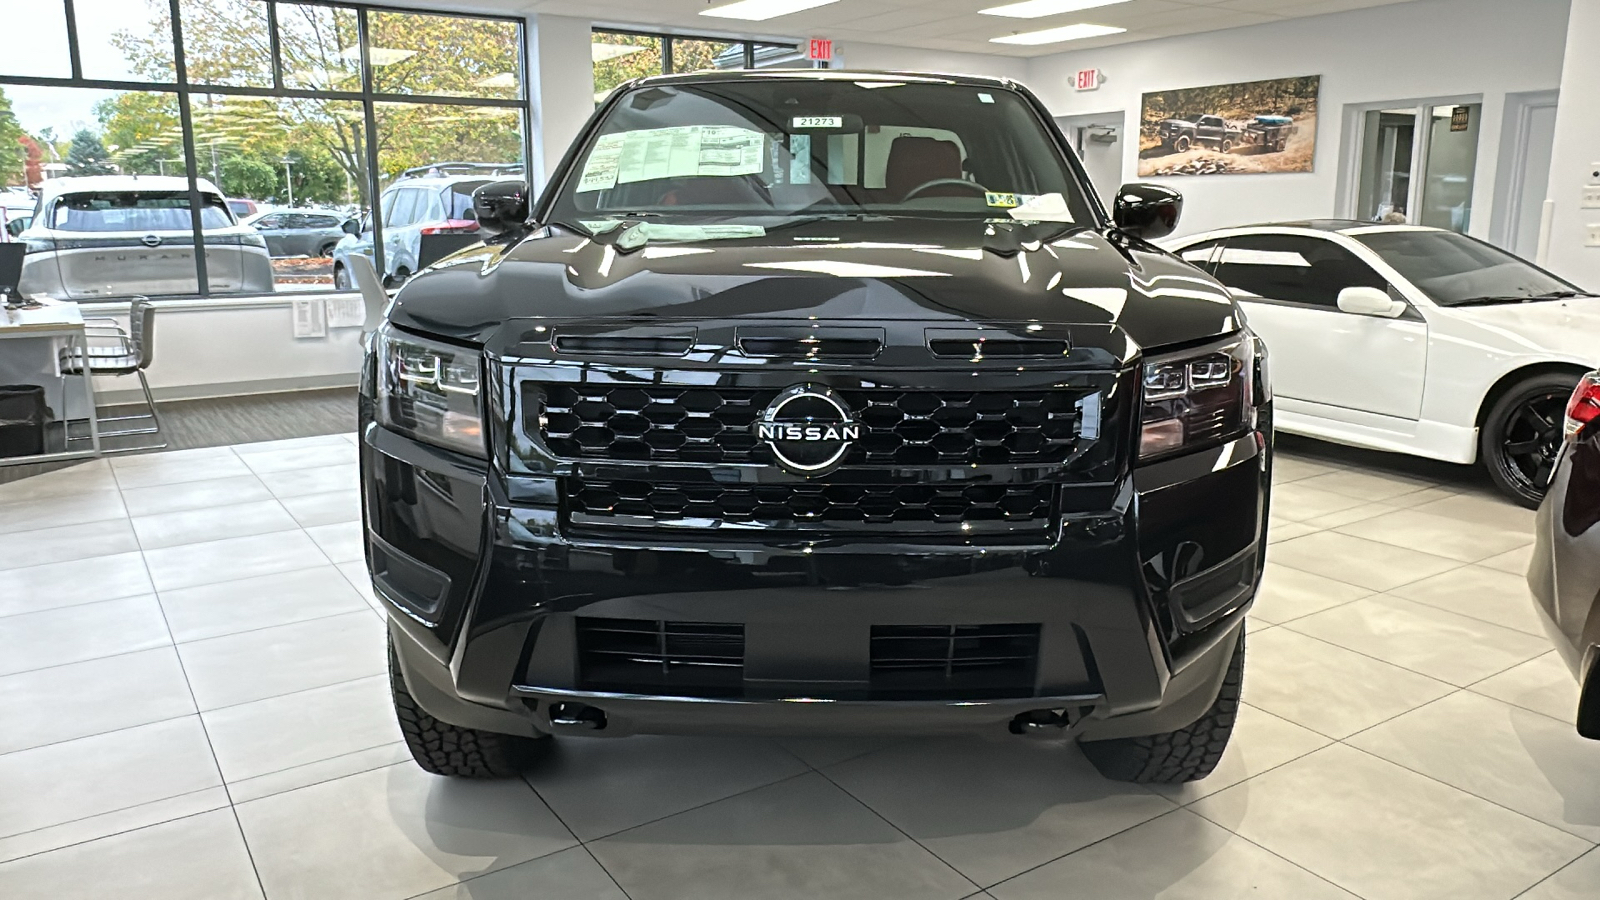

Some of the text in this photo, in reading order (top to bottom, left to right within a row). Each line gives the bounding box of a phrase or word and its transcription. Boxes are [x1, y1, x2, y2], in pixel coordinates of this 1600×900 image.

[810, 39, 832, 59] EXIT
[1078, 70, 1095, 88] EXIT
[800, 118, 834, 126] 21273
[759, 425, 859, 440] NISSAN
